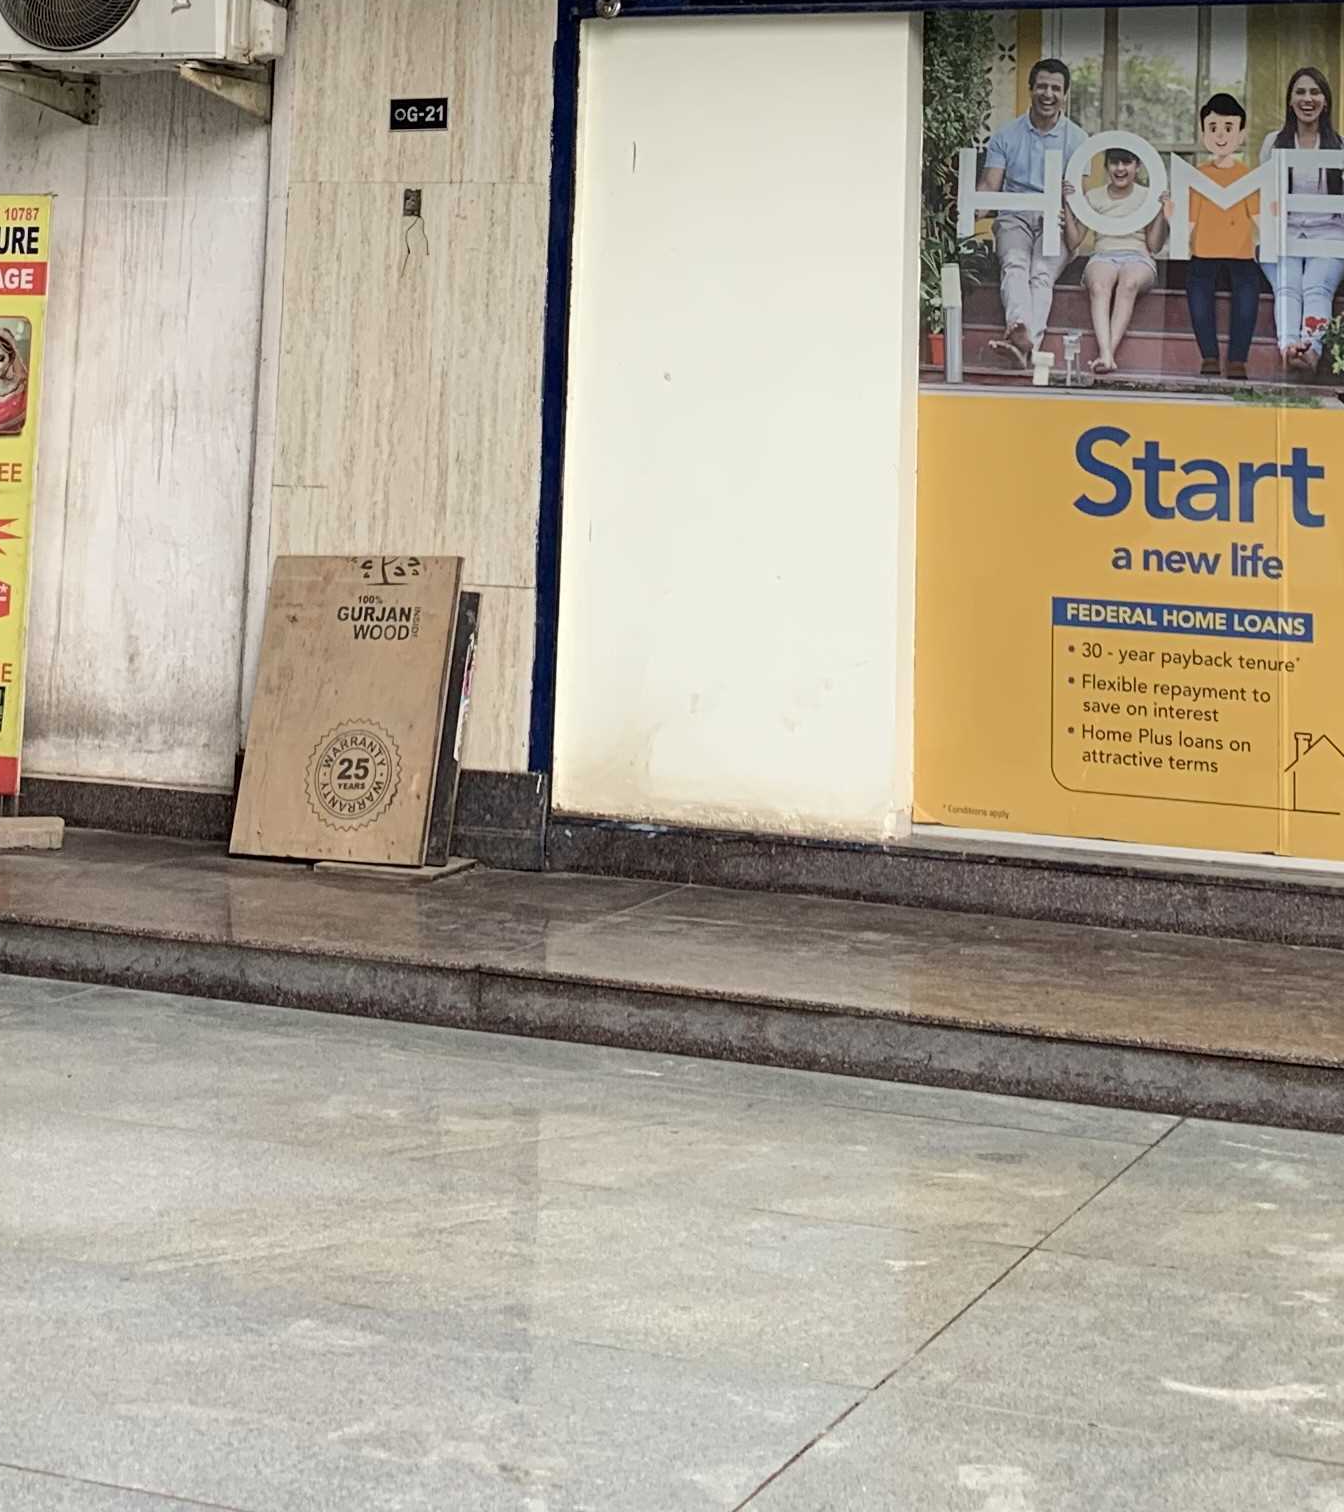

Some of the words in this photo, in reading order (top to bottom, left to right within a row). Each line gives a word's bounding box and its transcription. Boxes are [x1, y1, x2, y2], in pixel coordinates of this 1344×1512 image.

[4, 207, 40, 221] 10787
[1073, 425, 1326, 528] Start
[1143, 548, 1222, 577] new
[1231, 541, 1284, 580] life
[337, 606, 412, 622] GURJAN
[1066, 602, 1157, 627] FEDERAL
[1163, 607, 1227, 632] HOME
[1233, 613, 1305, 637] LOANS
[353, 624, 410, 641] WOOD
[1081, 642, 1103, 659] 30
[1118, 649, 1156, 665] year
[1160, 647, 1233, 670] payback
[1081, 674, 1148, 694] Flexible
[1153, 679, 1248, 704] repayment
[1082, 699, 1121, 715] save
[1153, 701, 1219, 723] interest
[1081, 724, 1133, 743] Home
[1138, 728, 1173, 747] Plus
[1178, 730, 1224, 751] loans
[323, 736, 386, 769] WARRANTY
[1081, 748, 1164, 769] attractive
[1168, 755, 1219, 774] terms
[337, 757, 370, 780] 25
[320, 780, 385, 813] WARRANTY
[337, 782, 366, 790] YEARS
